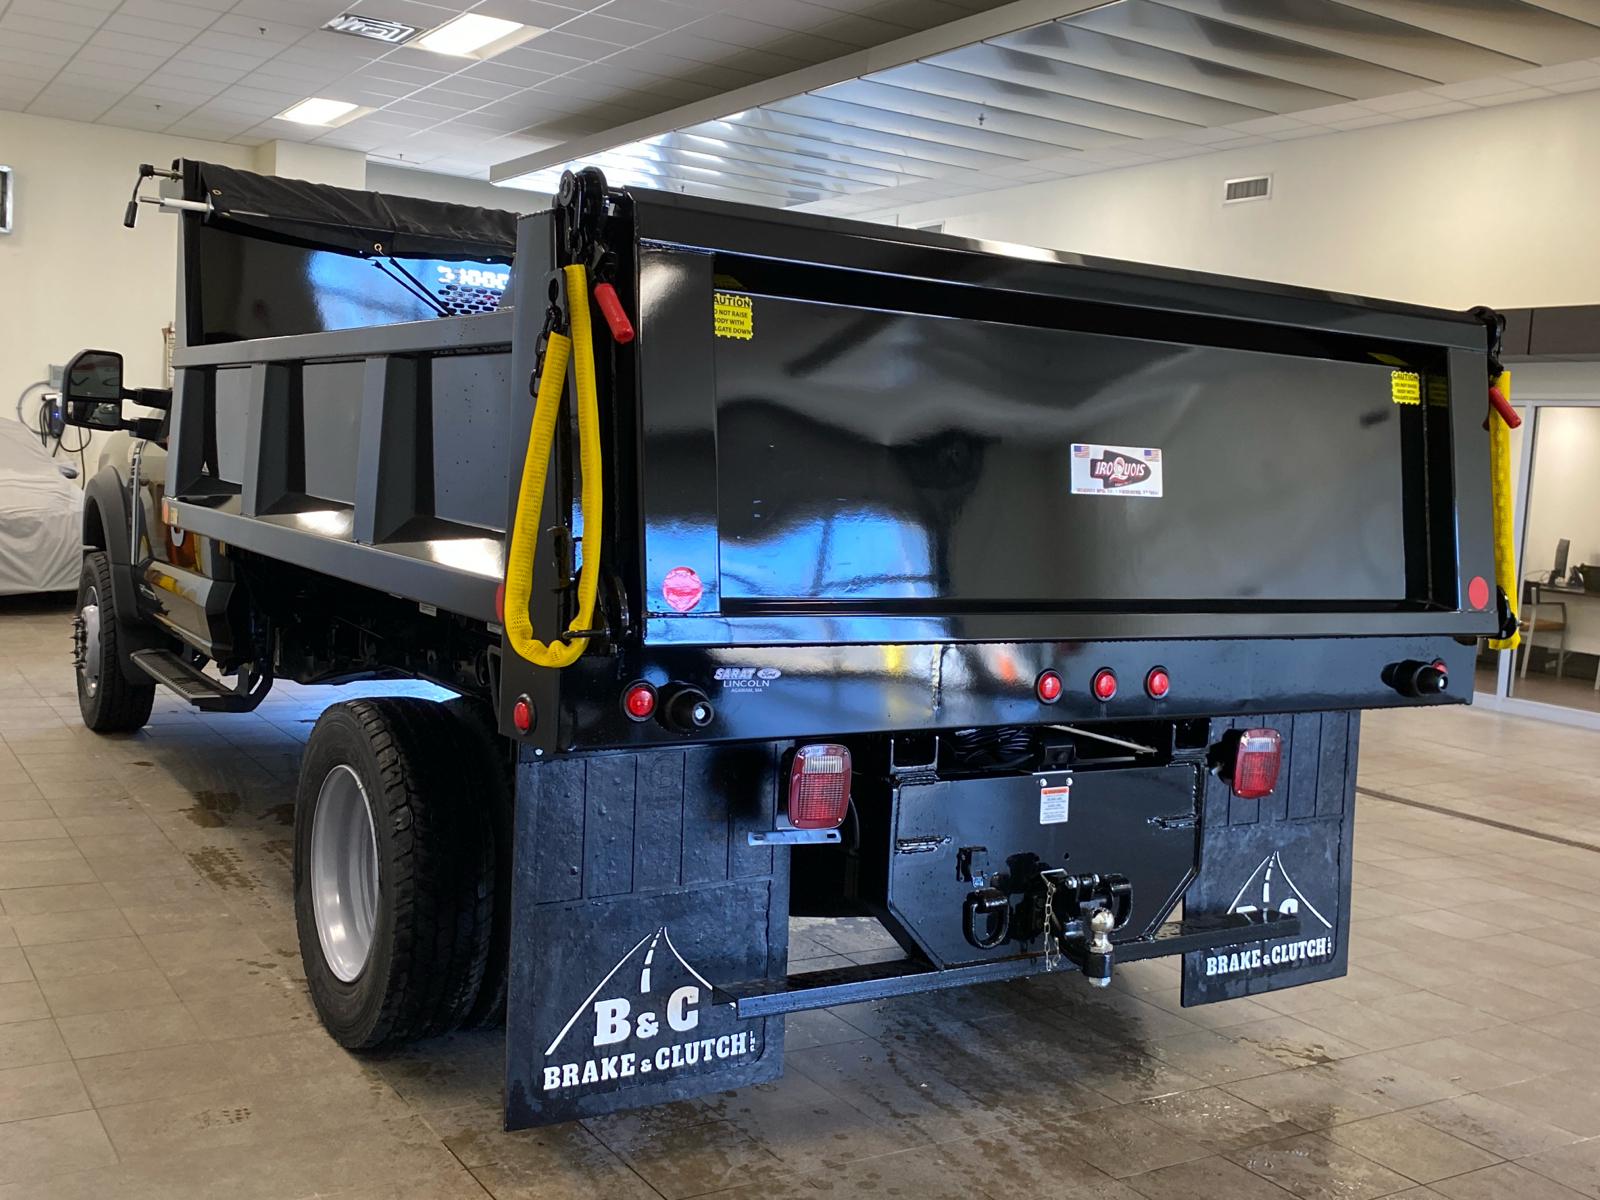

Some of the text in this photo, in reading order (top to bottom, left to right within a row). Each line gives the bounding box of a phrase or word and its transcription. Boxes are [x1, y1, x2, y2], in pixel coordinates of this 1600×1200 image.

[714, 296, 750, 308] AUTION
[732, 310, 748, 318] RAISE
[733, 327, 751, 335] DOWN
[1094, 457, 1146, 482] IROQUOIS
[714, 668, 756, 680] SARAT
[1206, 949, 1260, 976] BRAKE
[1262, 954, 1270, 965] &
[1271, 937, 1326, 964] CLUTCH
[593, 985, 699, 1046] B & C
[543, 1052, 636, 1090] BRAKE
[640, 1058, 652, 1073] &
[655, 1031, 747, 1070] CLUTCH
